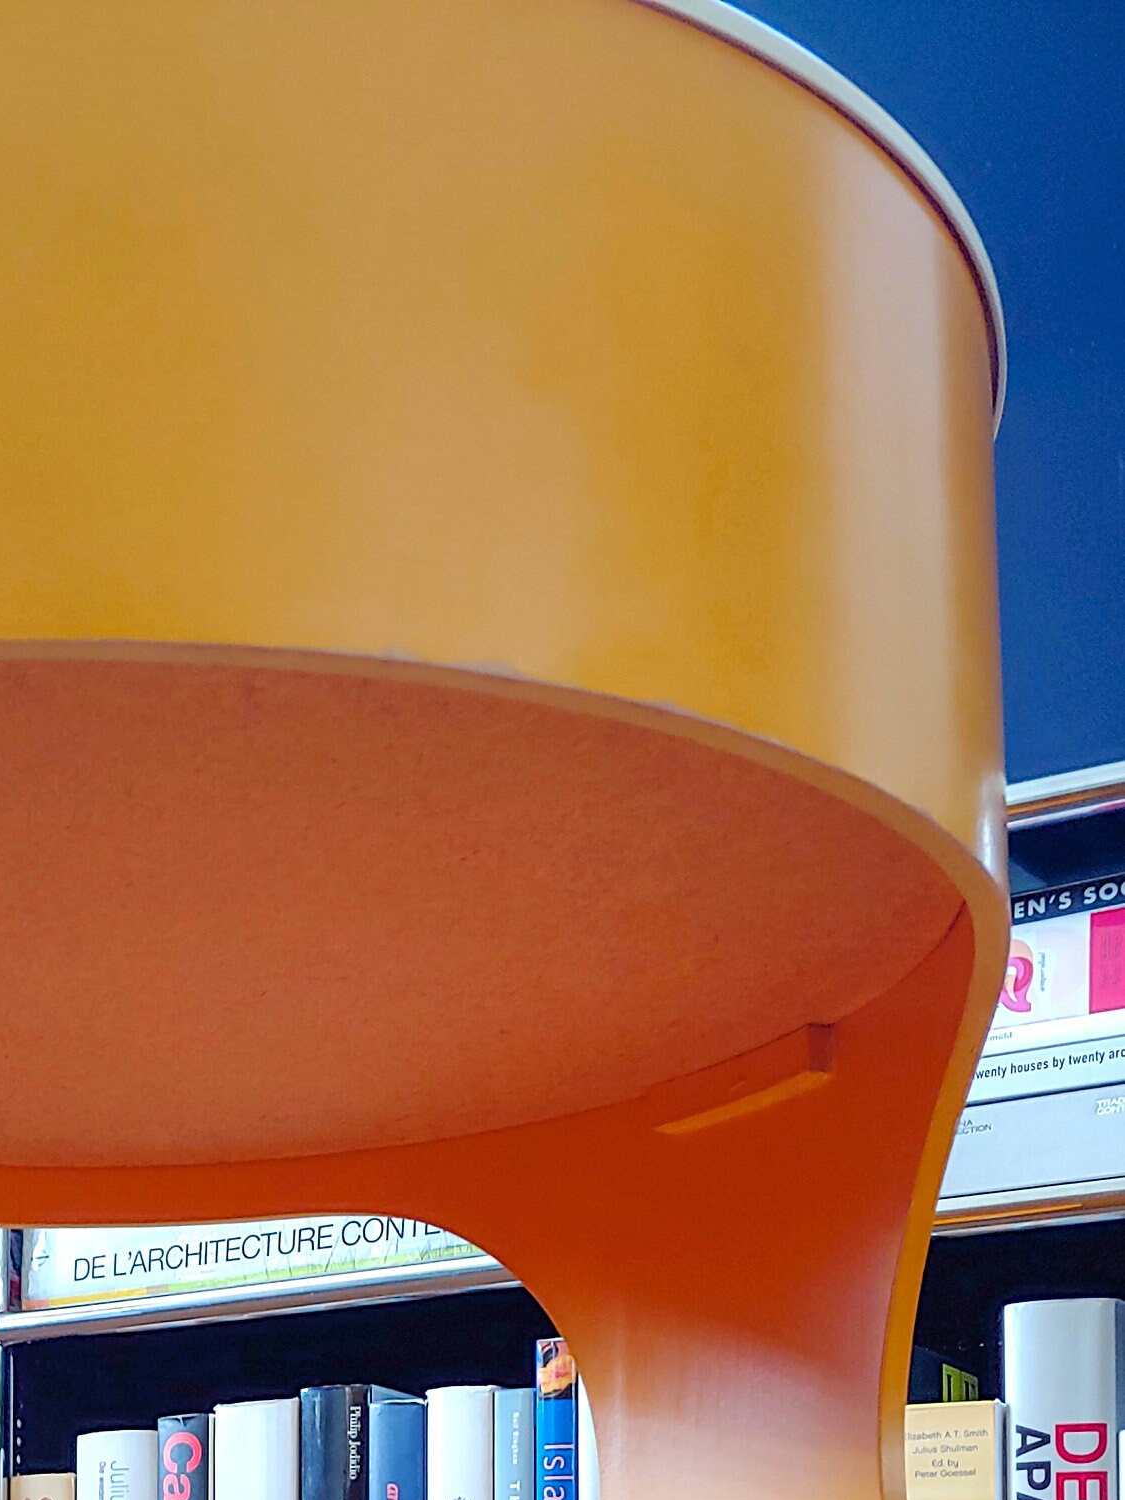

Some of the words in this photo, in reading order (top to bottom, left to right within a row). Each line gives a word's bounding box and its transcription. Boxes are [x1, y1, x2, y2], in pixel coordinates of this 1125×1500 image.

[1083, 881, 1125, 905] SO
[974, 1066, 1007, 1079] wenty
[1010, 1060, 1049, 1074] houses
[1052, 1056, 1066, 1070] by
[1069, 1050, 1106, 1065] twenty
[73, 1255, 106, 1283] DE
[113, 1223, 334, 1277] L'ARCHITECTURE
[963, 1429, 989, 1438] Smith
[912, 1446, 938, 1455] Julius
[940, 1444, 978, 1453] Shulman
[947, 1459, 959, 1469] by
[914, 1470, 938, 1479] Peter
